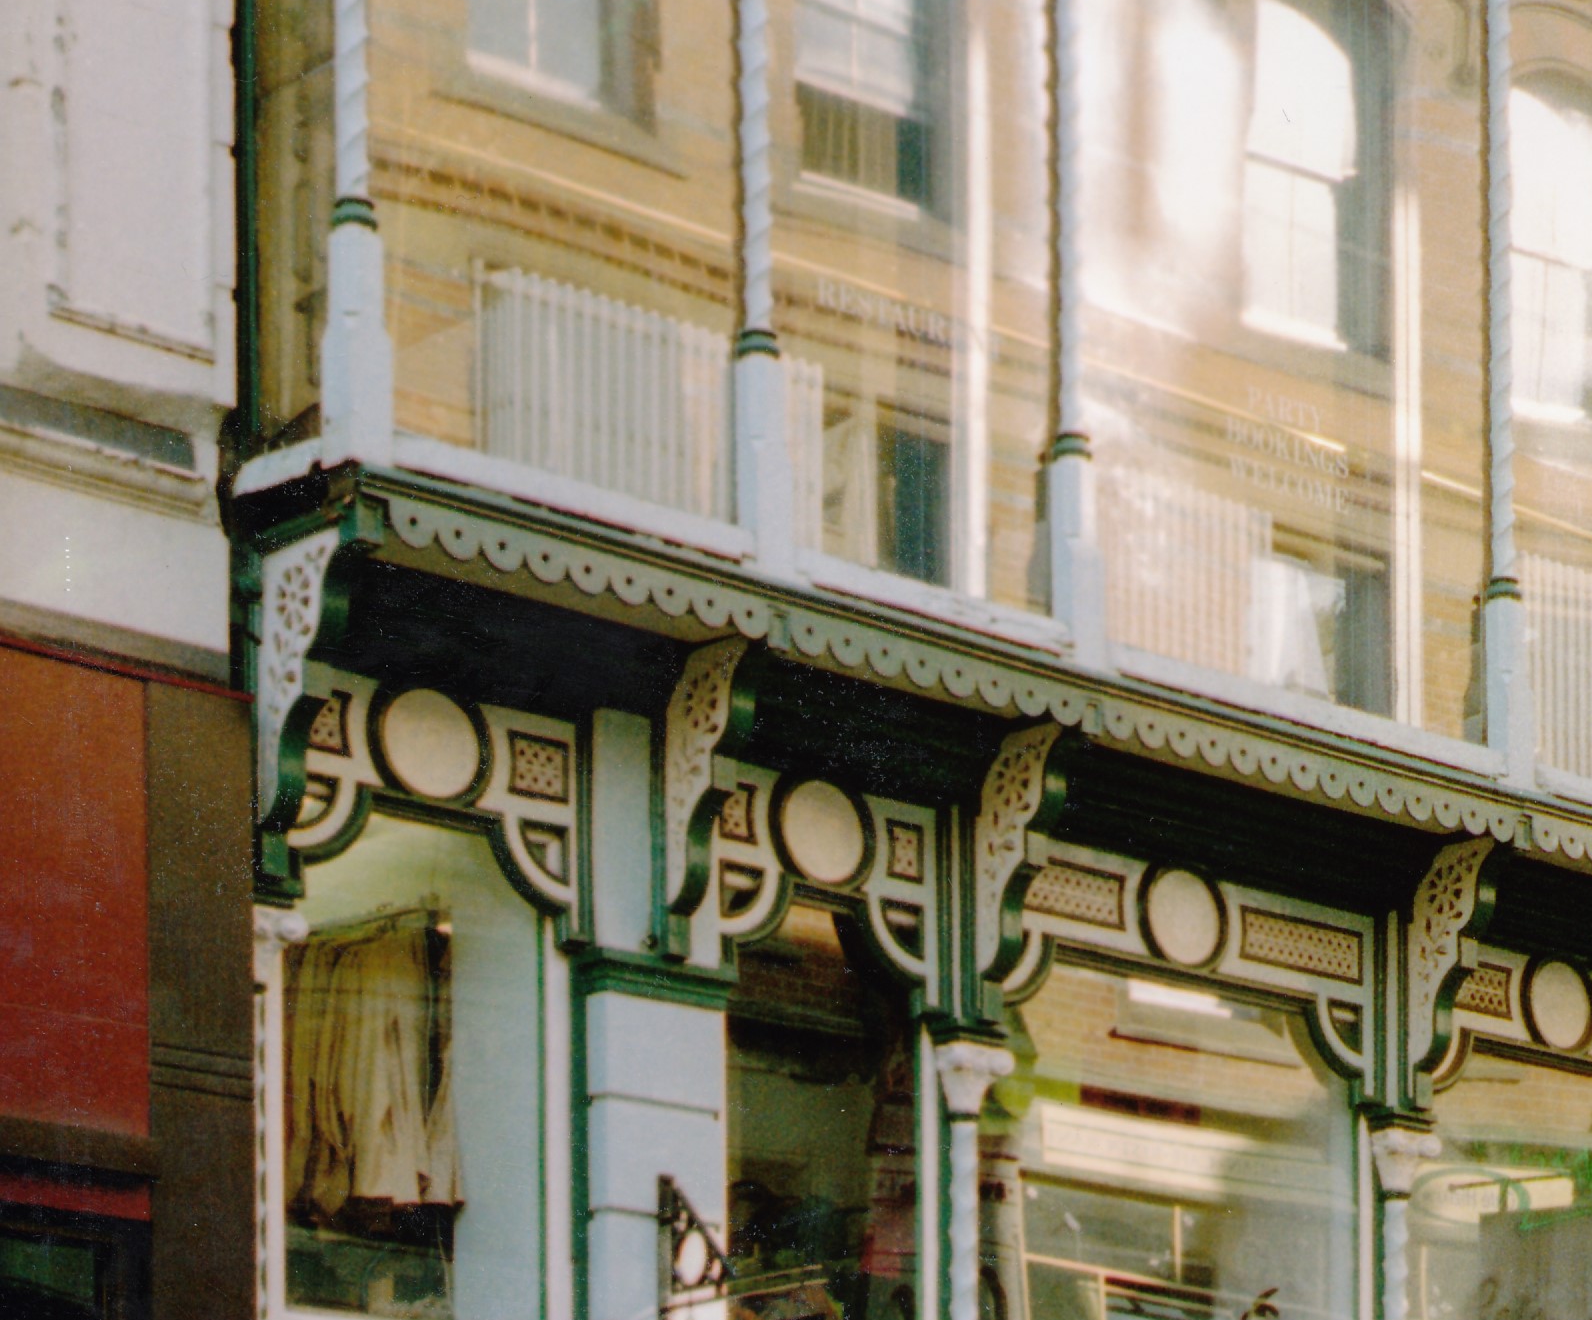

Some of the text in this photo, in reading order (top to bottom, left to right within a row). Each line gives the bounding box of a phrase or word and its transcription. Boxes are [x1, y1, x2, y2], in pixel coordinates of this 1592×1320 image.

[1247, 385, 1322, 432] PARTY
[1226, 416, 1348, 478] BOOKINGS
[1228, 453, 1349, 515] WELCOME
